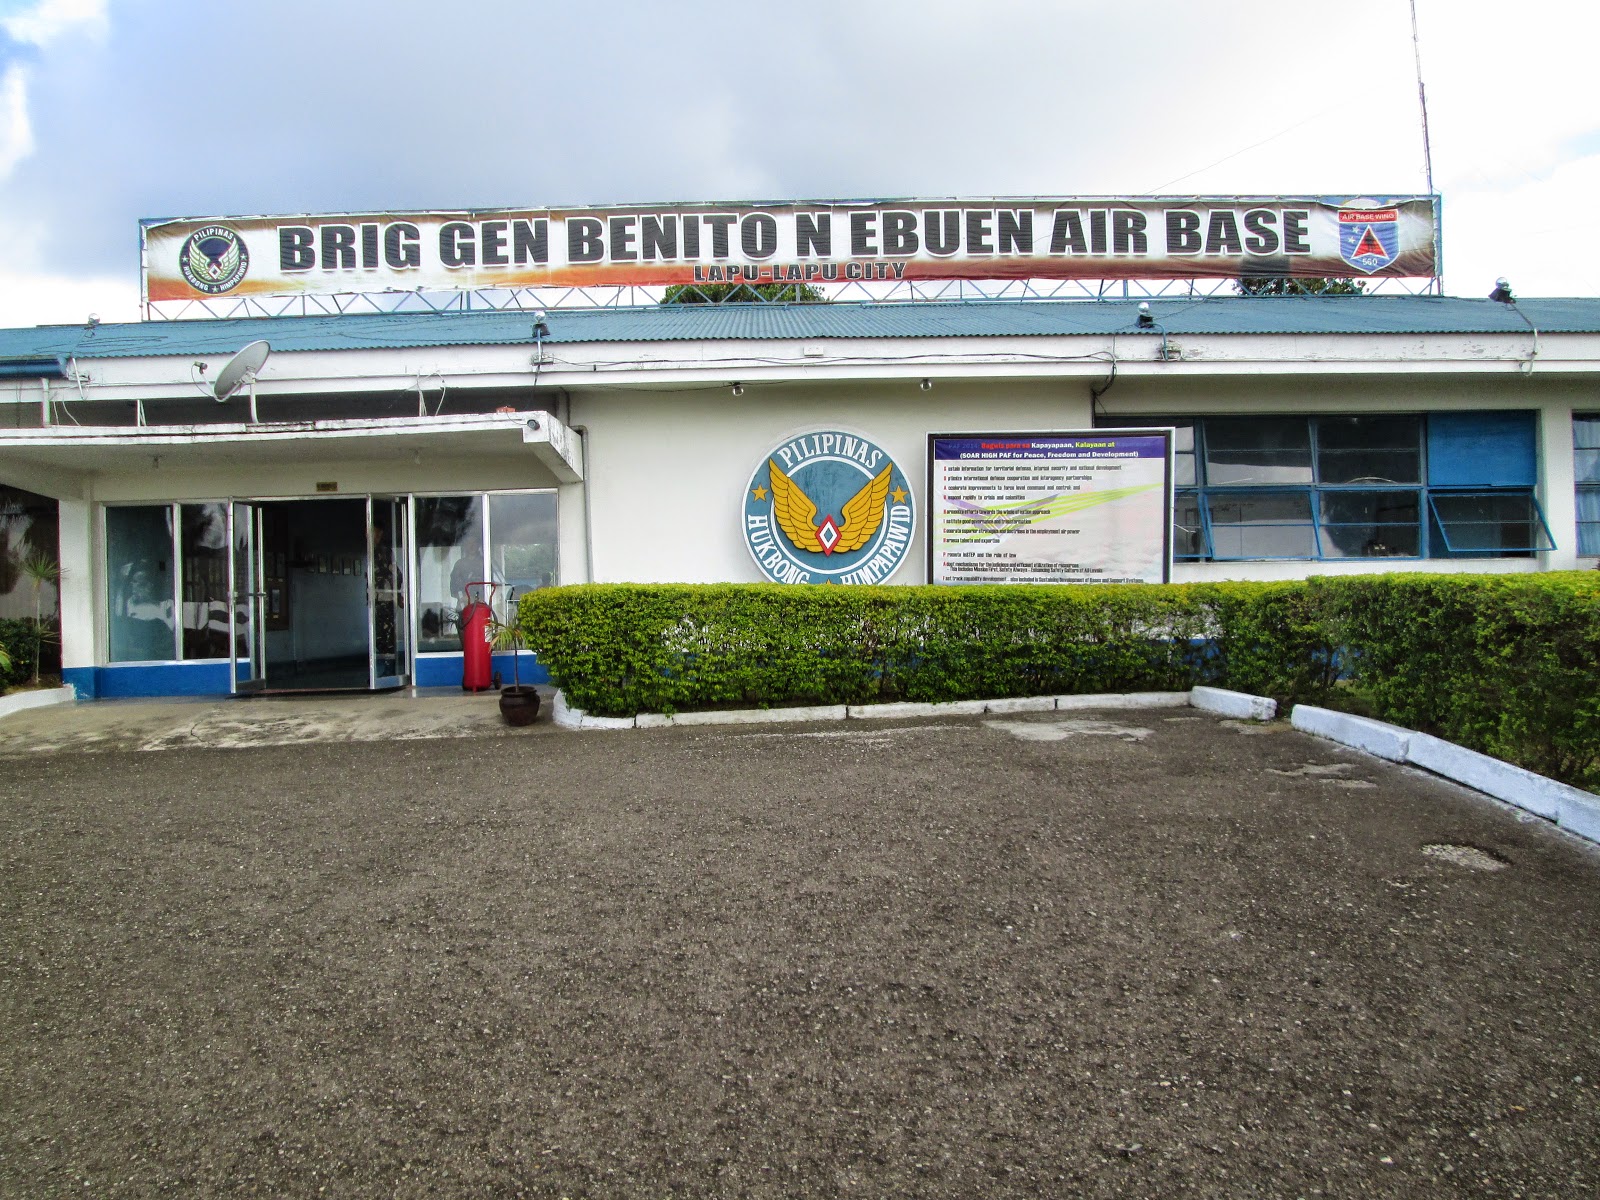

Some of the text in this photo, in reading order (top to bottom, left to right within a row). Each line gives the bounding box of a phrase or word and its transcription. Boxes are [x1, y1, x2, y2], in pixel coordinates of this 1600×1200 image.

[194, 228, 234, 241] PILIPINAS
[277, 208, 1312, 273] BRIG GEN BENITO N EBUEN AIR BASE
[220, 262, 247, 291] HIMPAPAWID
[694, 262, 907, 282] LAPU-LAPU CITY
[1362, 258, 1378, 266] 560
[183, 266, 208, 290] HUKBONG
[777, 434, 883, 469] PILIPINAS
[748, 514, 811, 584] HUKBONG
[840, 505, 911, 585] HIMPAPAWID
